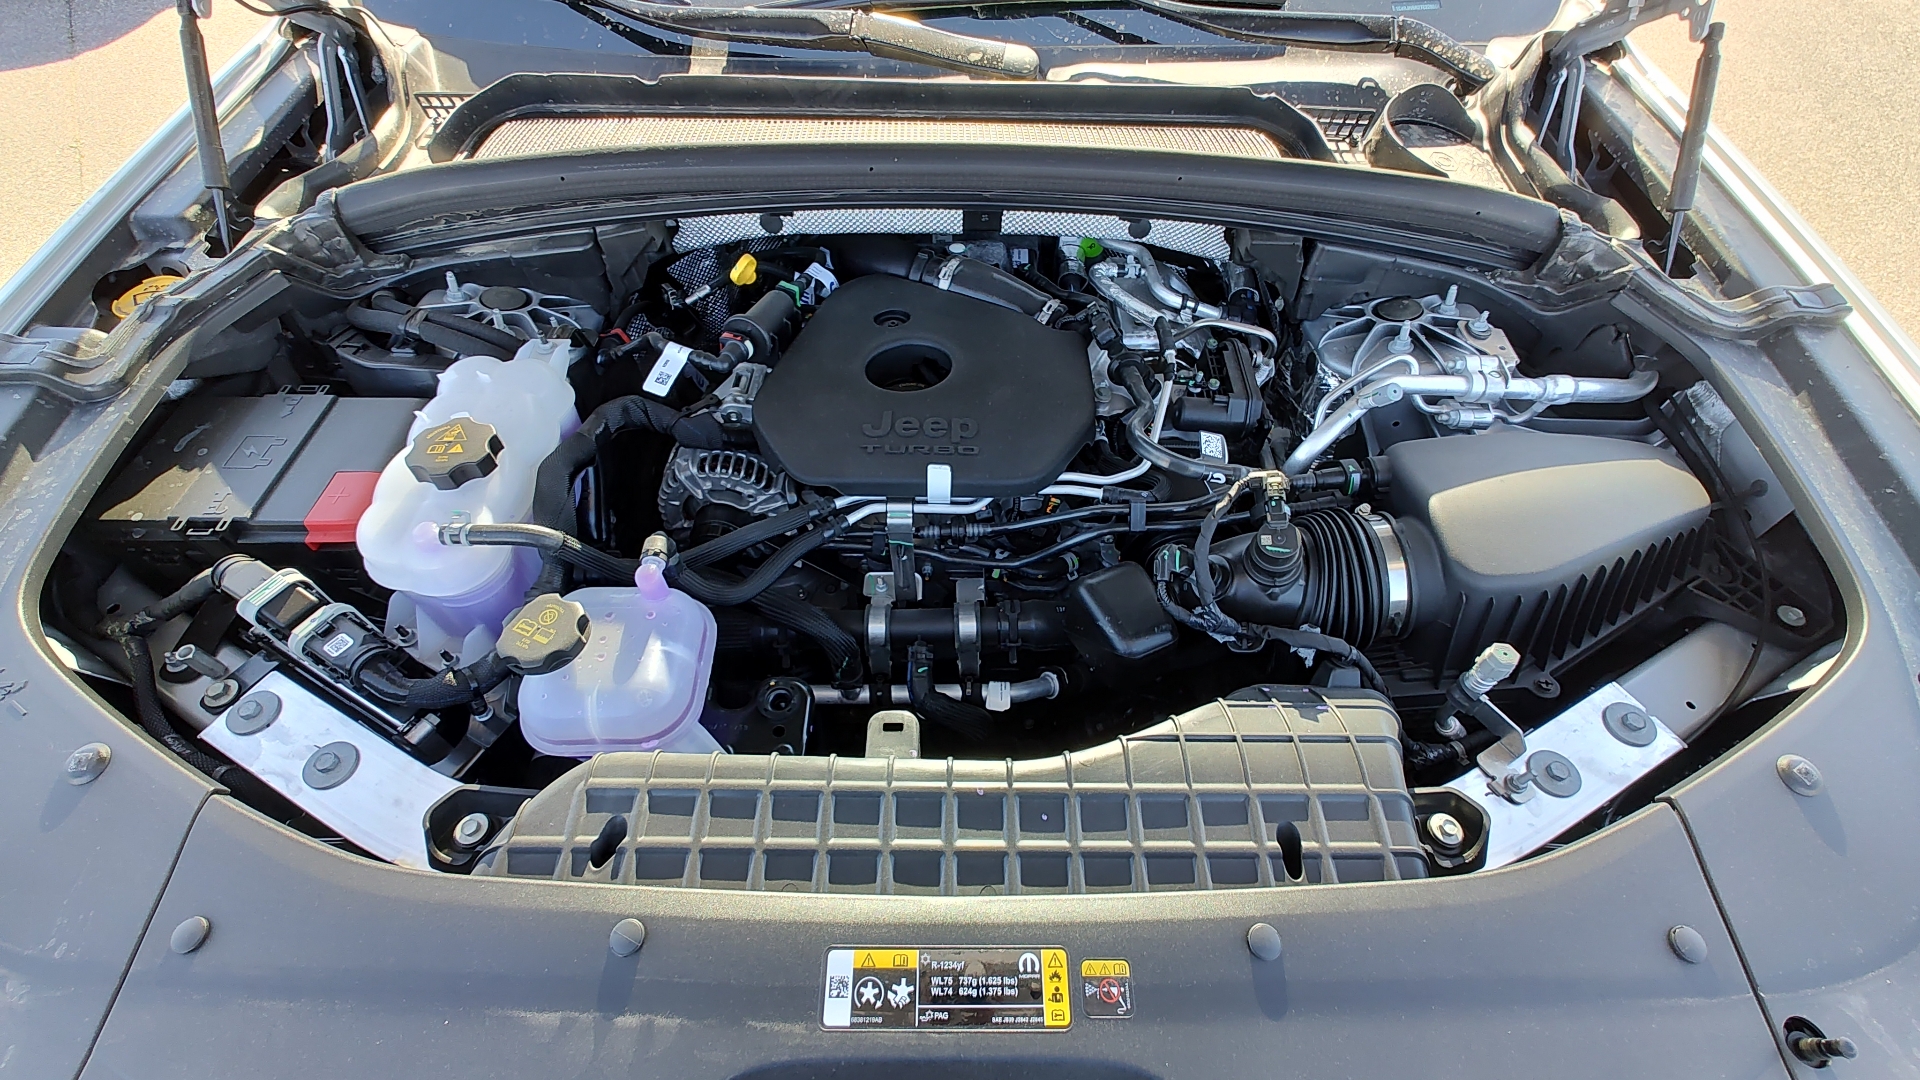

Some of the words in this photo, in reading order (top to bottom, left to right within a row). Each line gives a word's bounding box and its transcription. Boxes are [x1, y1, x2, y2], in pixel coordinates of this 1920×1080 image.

[862, 410, 979, 444] Jeep
[860, 444, 980, 456] TURBO
[931, 961, 965, 972] R-1234yf
[930, 976, 953, 986] WL75
[958, 976, 978, 987] 737g
[979, 976, 1002, 987] (1.625
[1003, 976, 1019, 987] lbs)
[930, 987, 953, 997] WL74
[958, 987, 978, 998] 624g
[979, 987, 1002, 998] (1.375
[1003, 987, 1019, 998] lbs)
[934, 1011, 949, 1020] PAG
